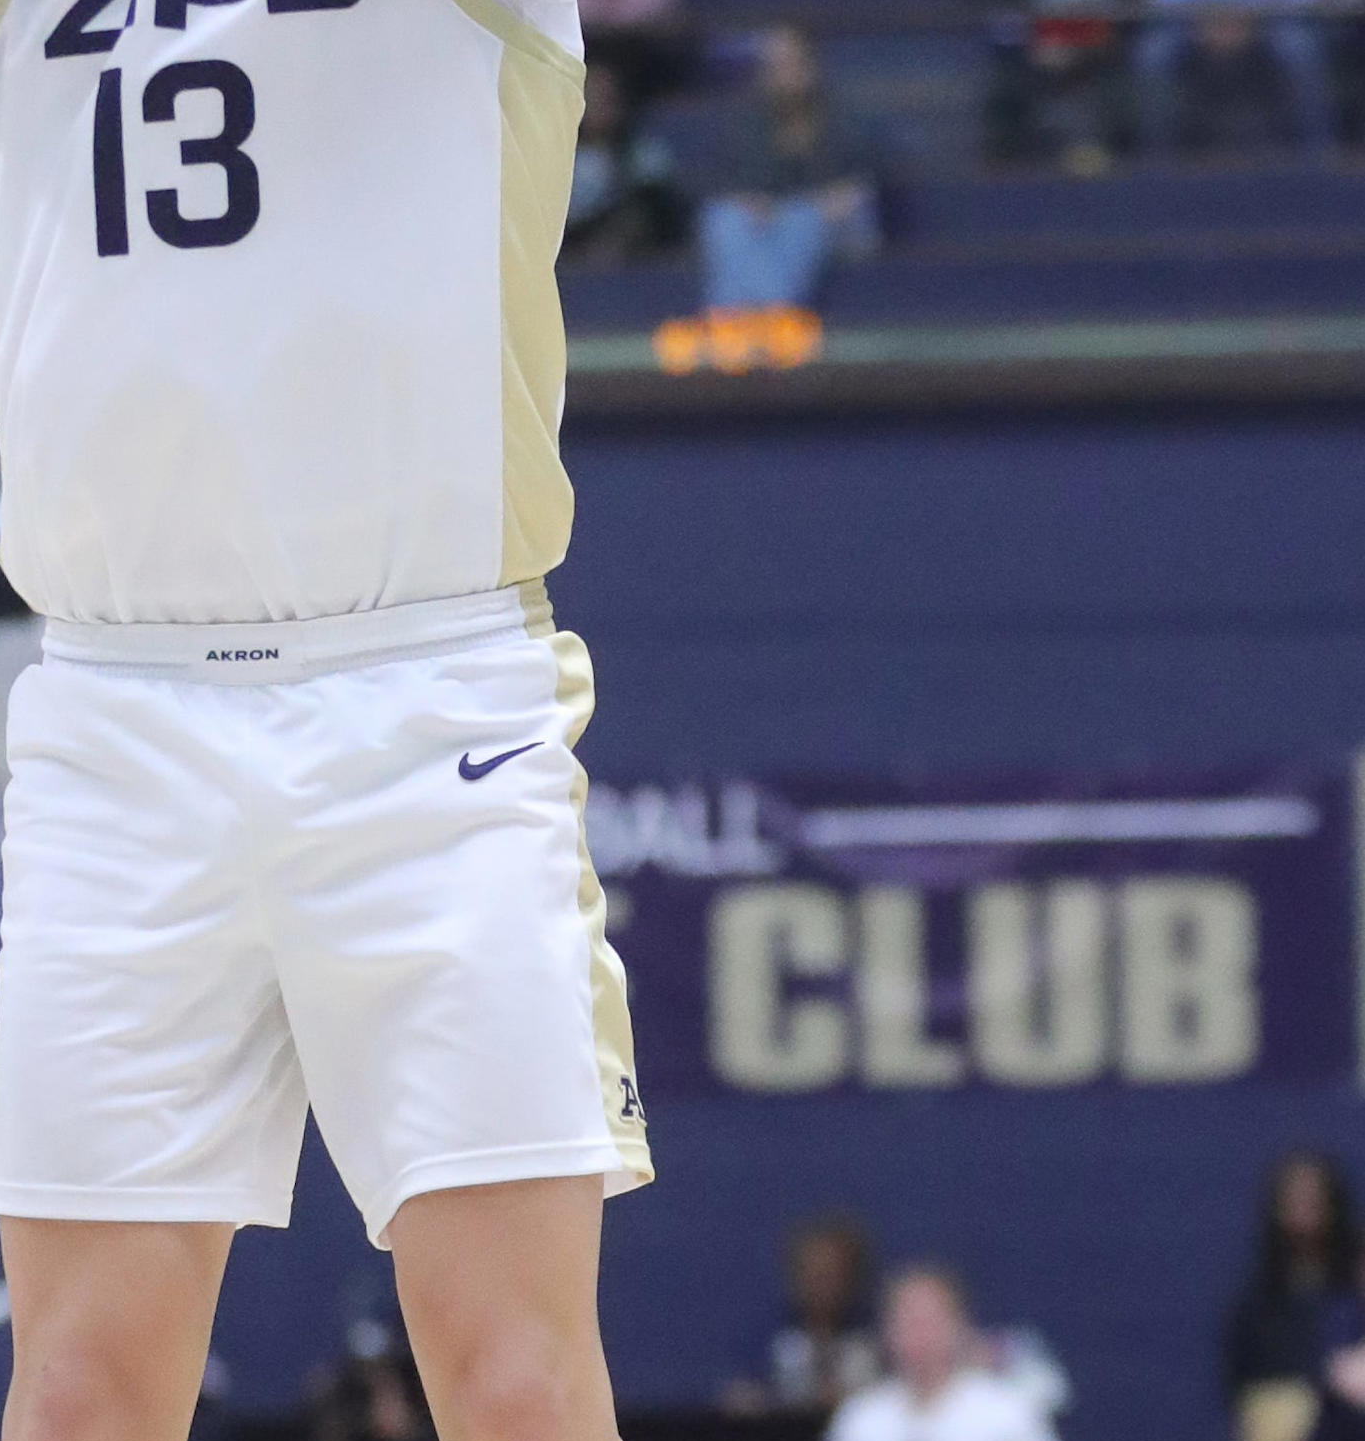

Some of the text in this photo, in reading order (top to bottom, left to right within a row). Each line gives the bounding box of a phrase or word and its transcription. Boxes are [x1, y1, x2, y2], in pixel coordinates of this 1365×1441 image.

[93, 59, 261, 257] 13
[205, 648, 280, 662] AKRON
[709, 875, 1260, 1091] CLUB
